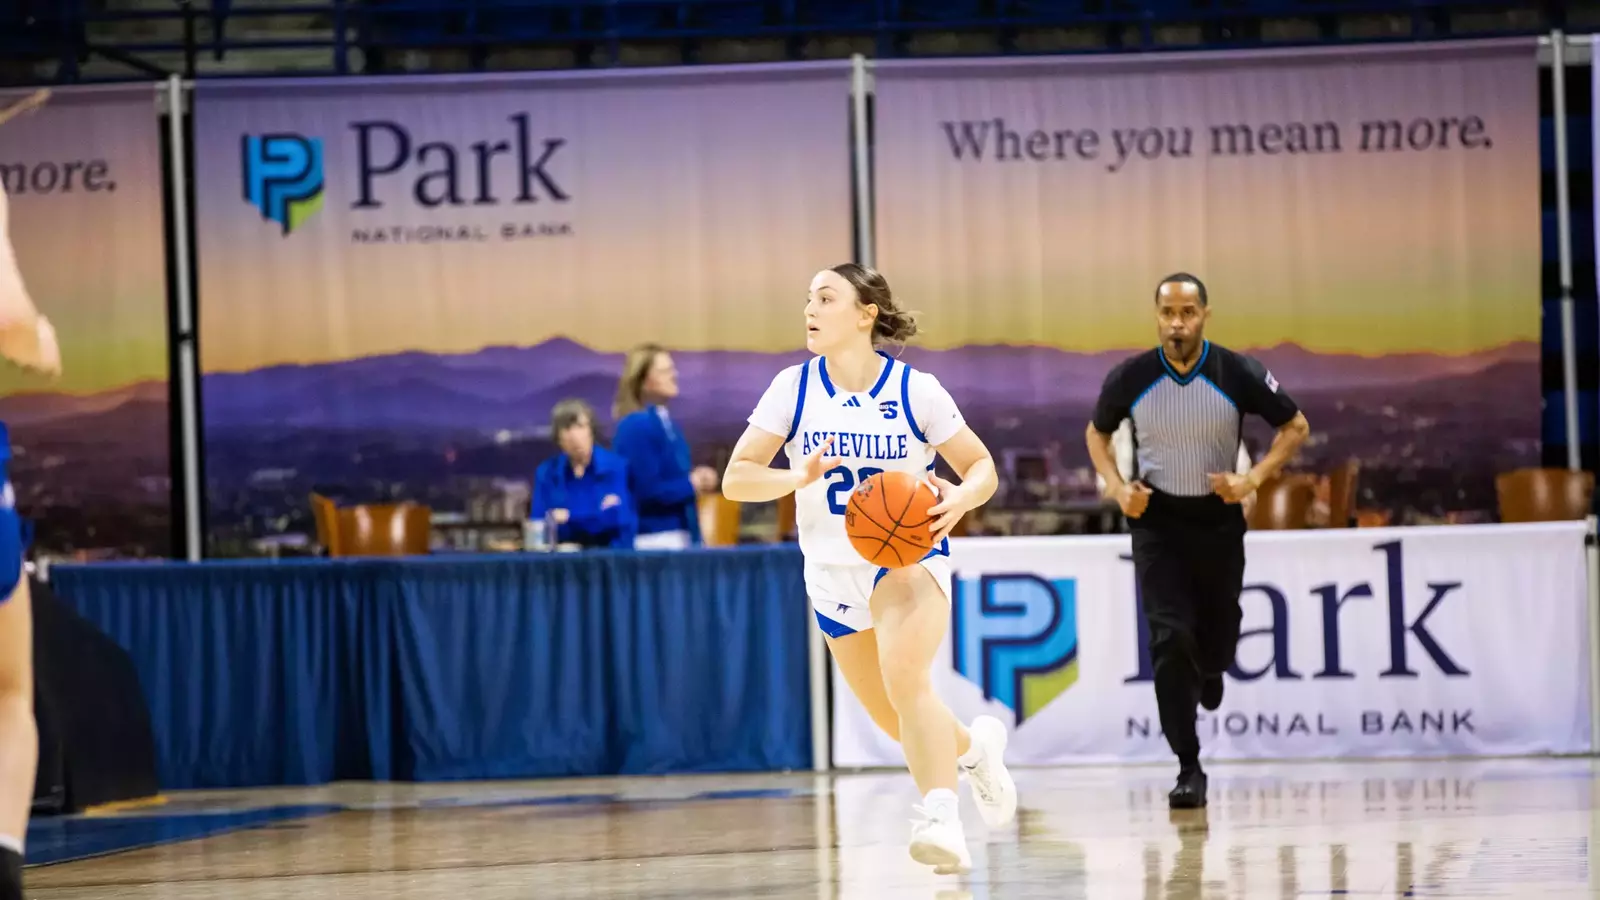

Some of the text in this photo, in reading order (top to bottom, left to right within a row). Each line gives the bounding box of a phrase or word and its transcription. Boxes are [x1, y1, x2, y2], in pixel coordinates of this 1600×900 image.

[349, 111, 570, 209] Park
[940, 114, 1494, 173] Where you mean more.
[351, 222, 576, 244] NATIONAL BANK
[803, 431, 908, 460] ASHEVILLE
[824, 465, 885, 516] 2
[1126, 709, 1476, 739] NIONAL BANK
